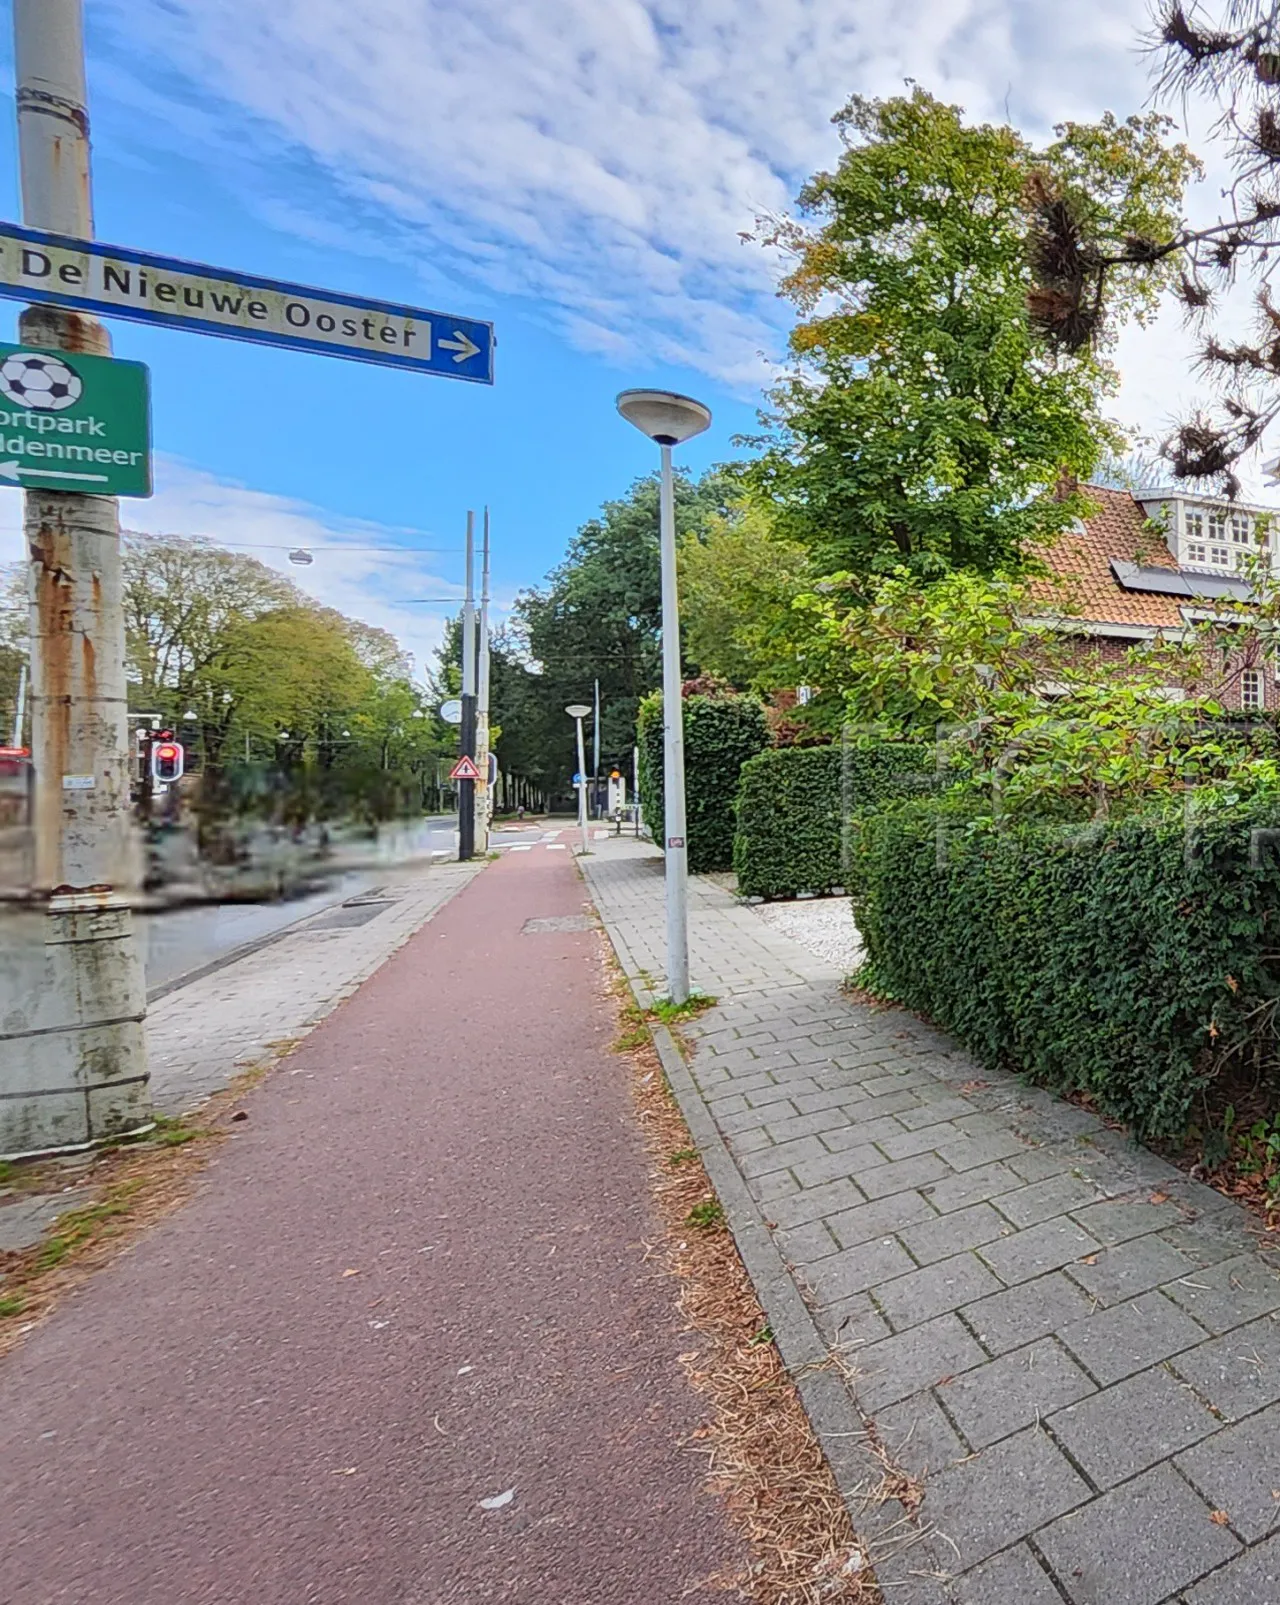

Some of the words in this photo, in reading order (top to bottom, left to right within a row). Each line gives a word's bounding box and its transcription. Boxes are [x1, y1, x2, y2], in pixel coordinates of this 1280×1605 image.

[22, 248, 83, 285] De
[103, 265, 268, 319] Nieuwe
[285, 302, 416, 347] Ooster
